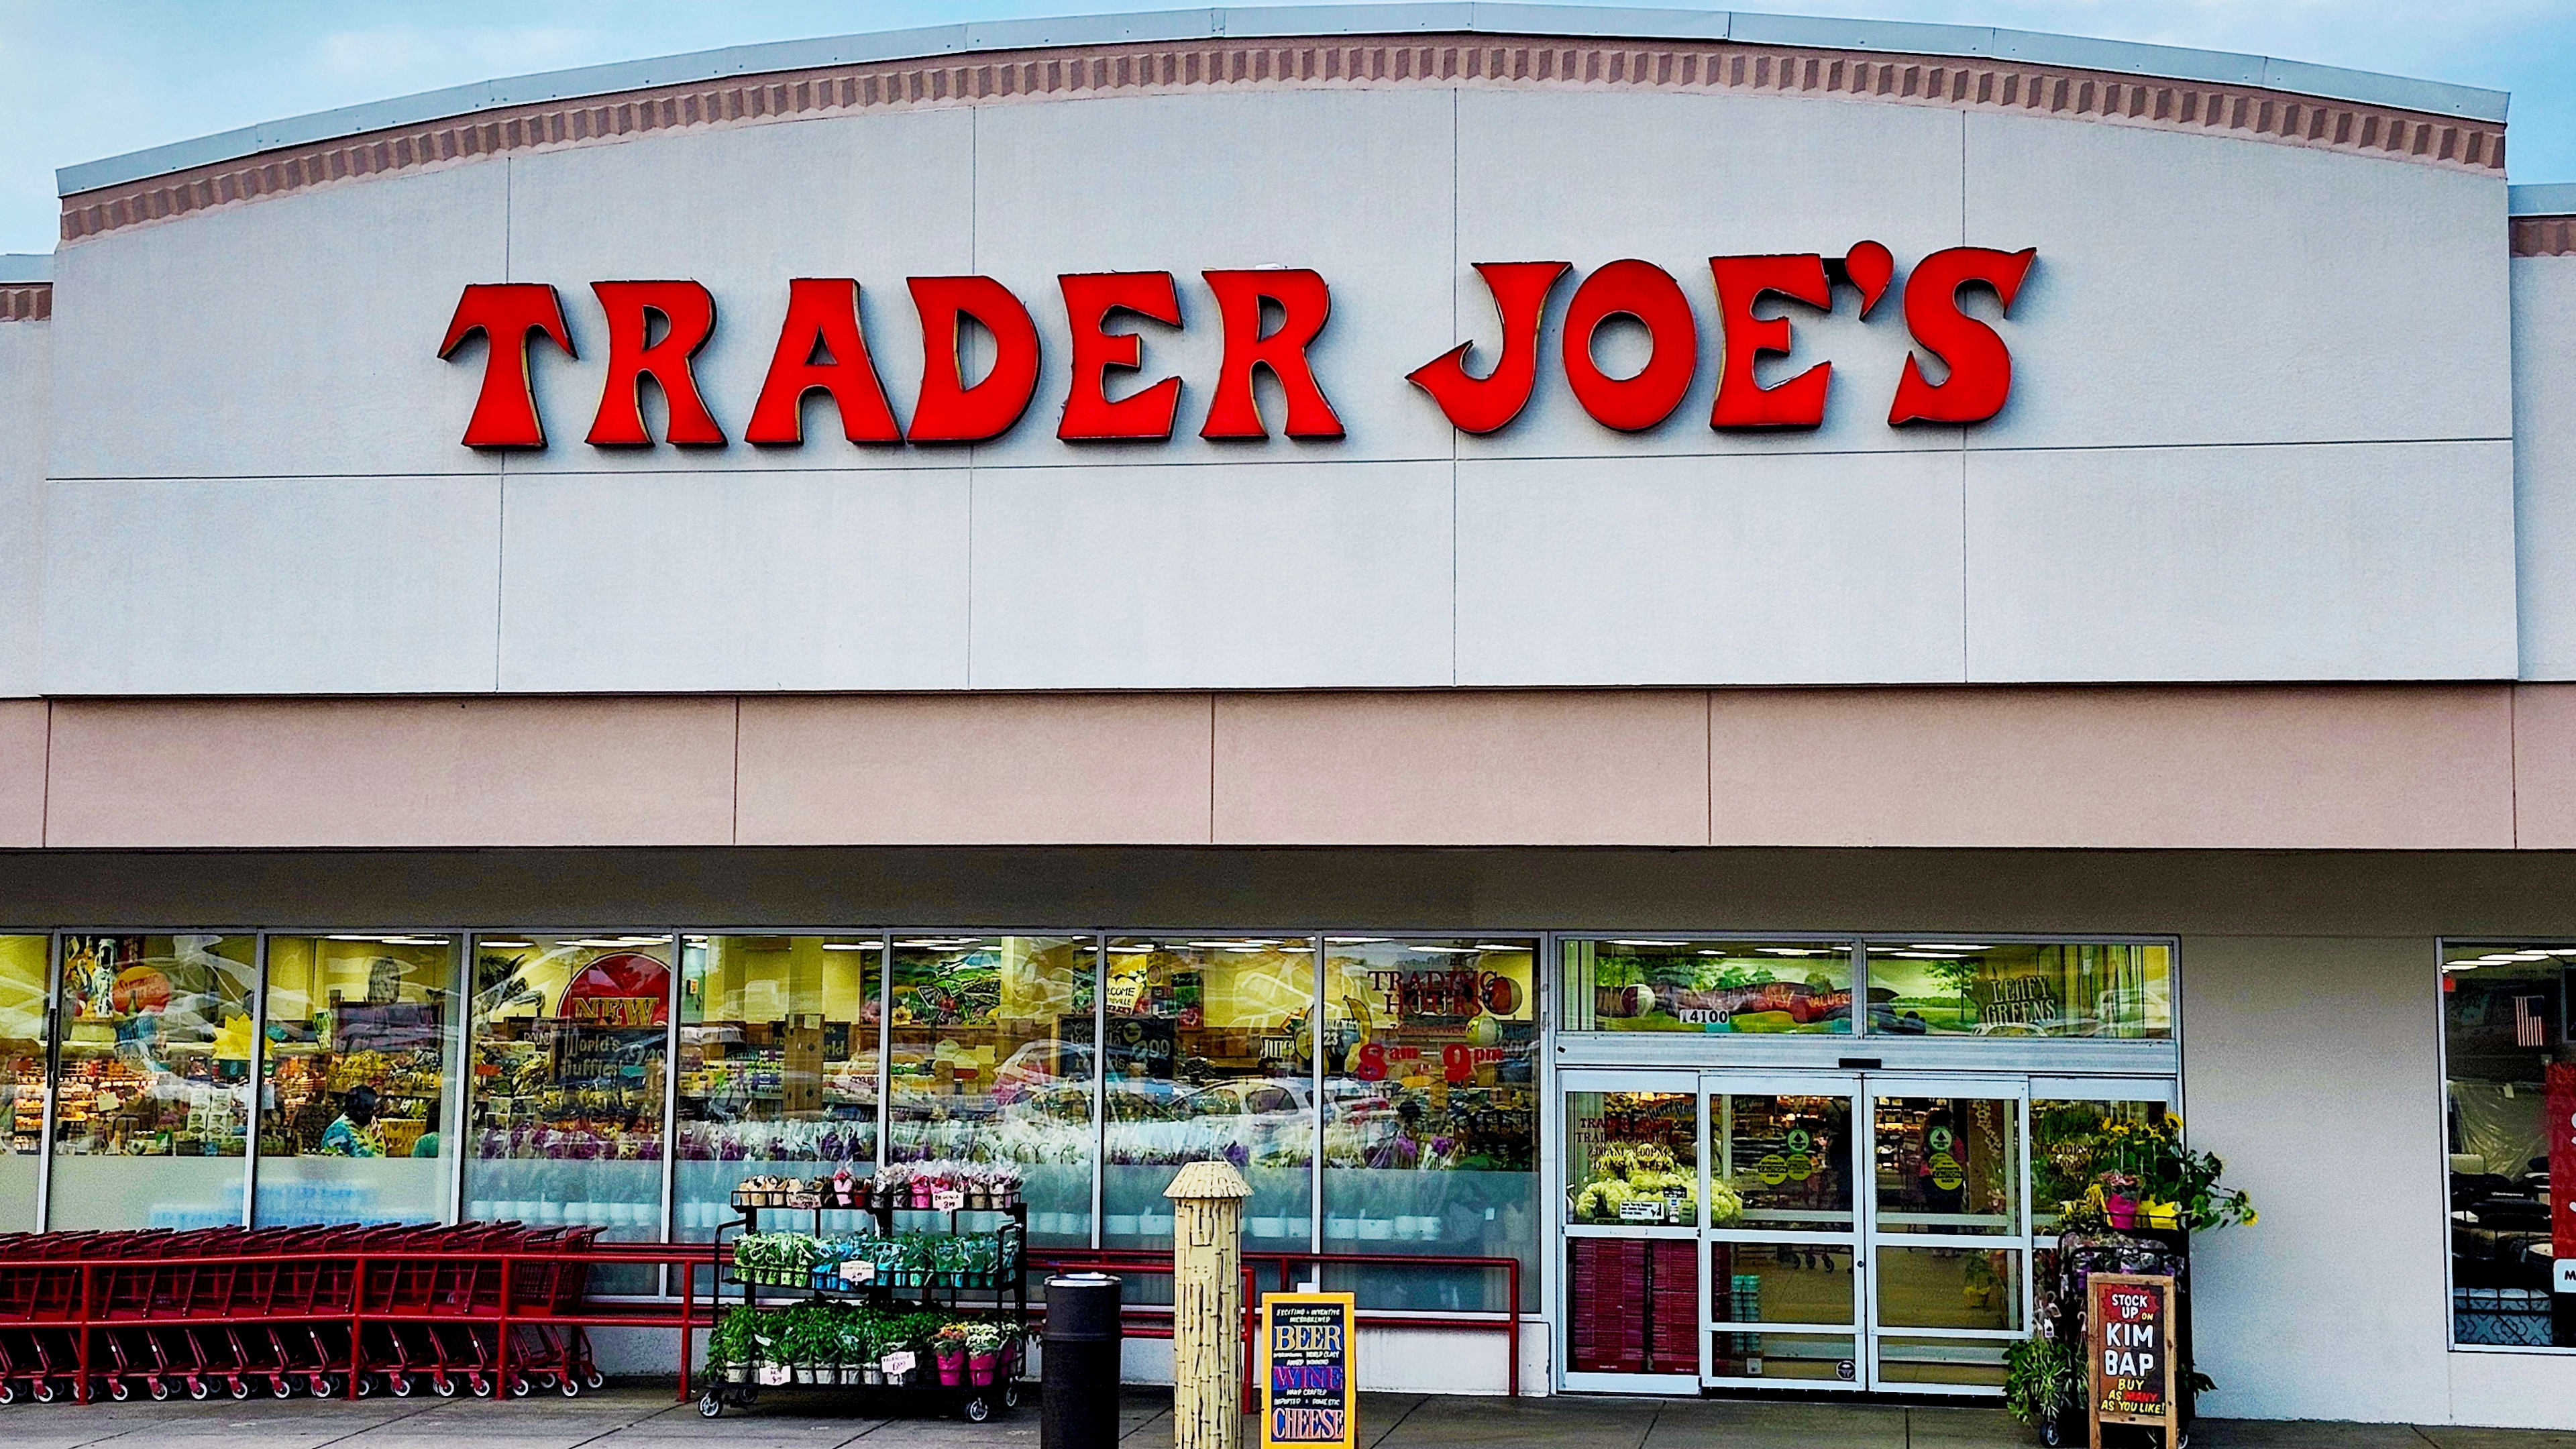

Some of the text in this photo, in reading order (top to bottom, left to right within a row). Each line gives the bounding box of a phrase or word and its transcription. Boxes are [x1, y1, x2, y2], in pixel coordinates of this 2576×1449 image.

[438, 239, 2037, 448] TRADER JOE'S
[1368, 970, 1497, 991] TRADING
[1991, 975, 2050, 1003] LEAFY
[572, 998, 659, 1026] NEW
[1383, 993, 1483, 1016] HOURS
[1986, 999, 2056, 1027] GREENS
[1680, 1010, 1728, 1024] 14100
[2112, 1294, 2148, 1307] STOCK
[2121, 1307, 2153, 1321] UP ON
[1275, 1325, 1342, 1351] BEER
[2106, 1322, 2153, 1348] KIM
[2104, 1350, 2154, 1377] BAP
[1273, 1366, 1342, 1389] WINE
[2118, 1379, 2144, 1390] BUY
[2100, 1399, 2165, 1414] AS YOU LIKE!
[2108, 1389, 2158, 1402] AS MANY
[1272, 1408, 1344, 1439] CHEESE
